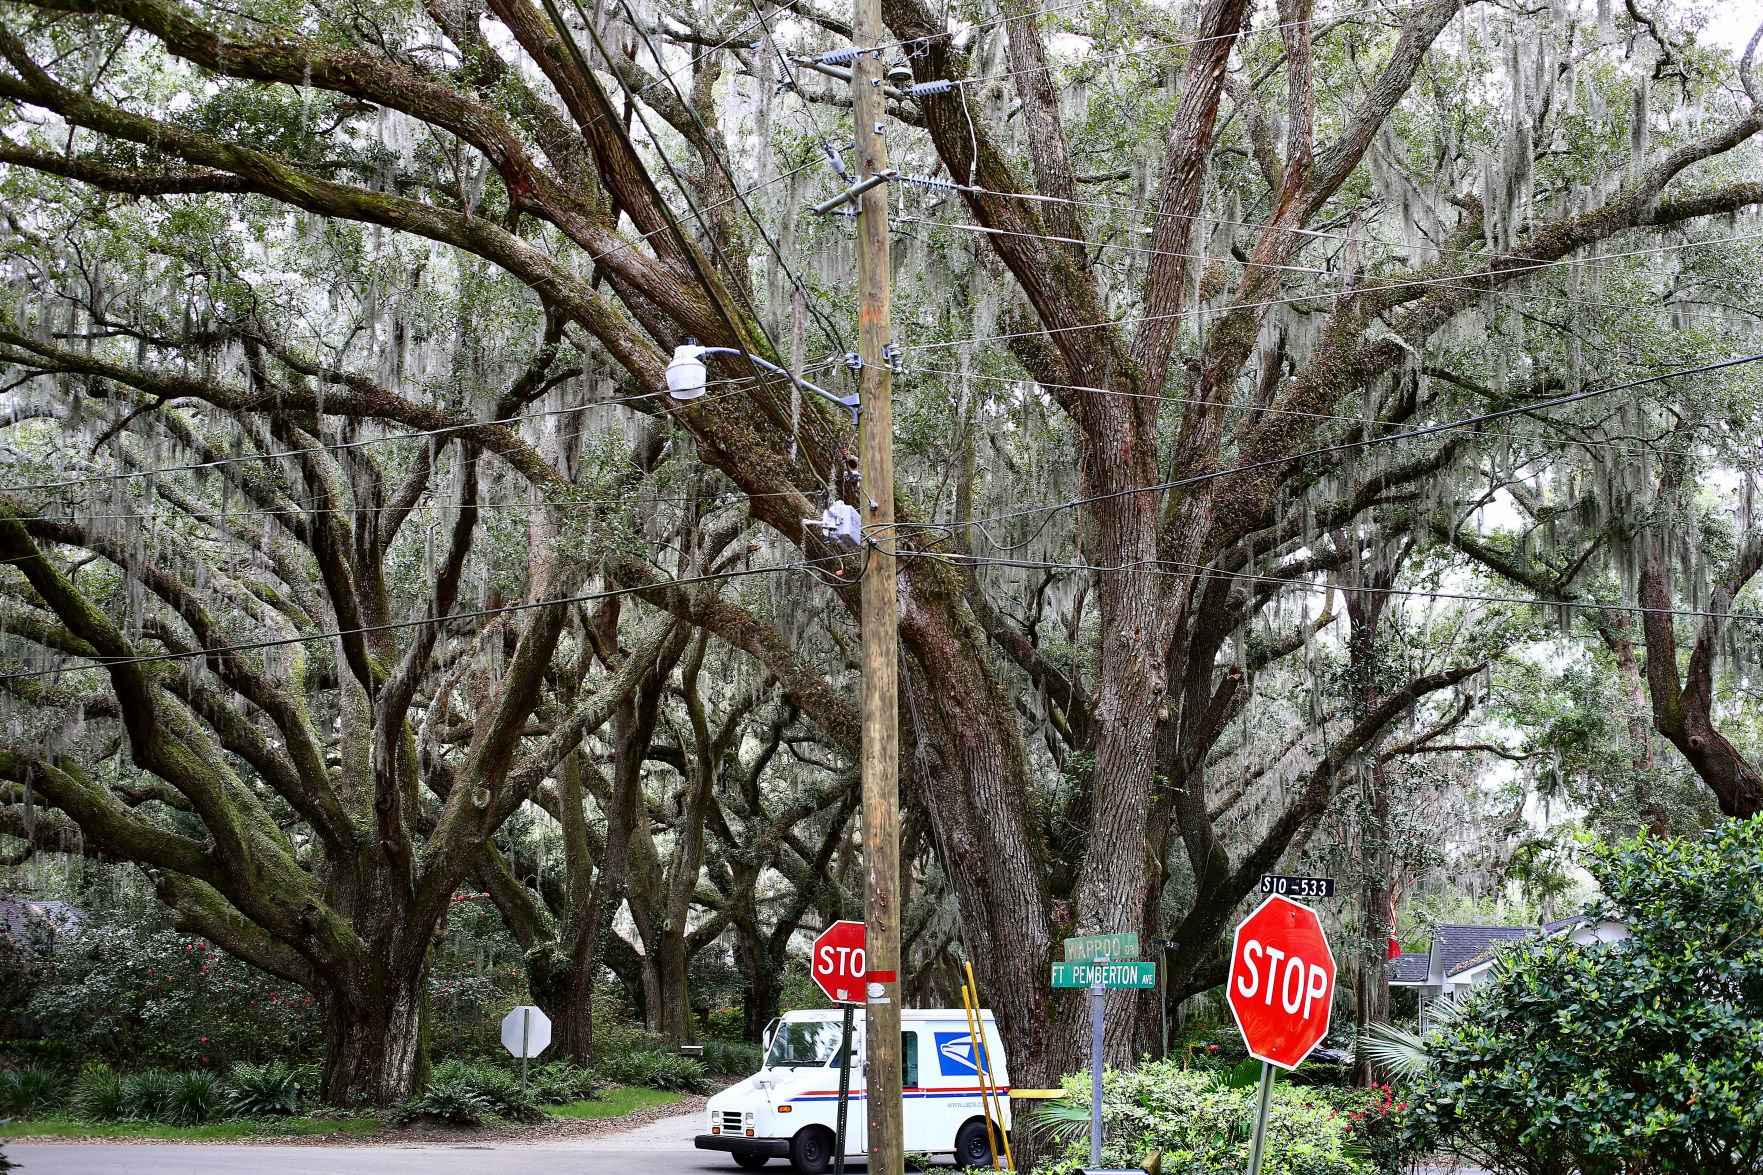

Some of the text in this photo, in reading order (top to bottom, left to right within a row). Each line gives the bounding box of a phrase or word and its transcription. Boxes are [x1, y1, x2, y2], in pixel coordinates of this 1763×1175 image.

[817, 945, 866, 978] STO
[1067, 938, 1121, 960] WAPPOO
[1051, 965, 1153, 985] FT PEMBERTON AVE
[1237, 939, 1328, 1020] STOP
